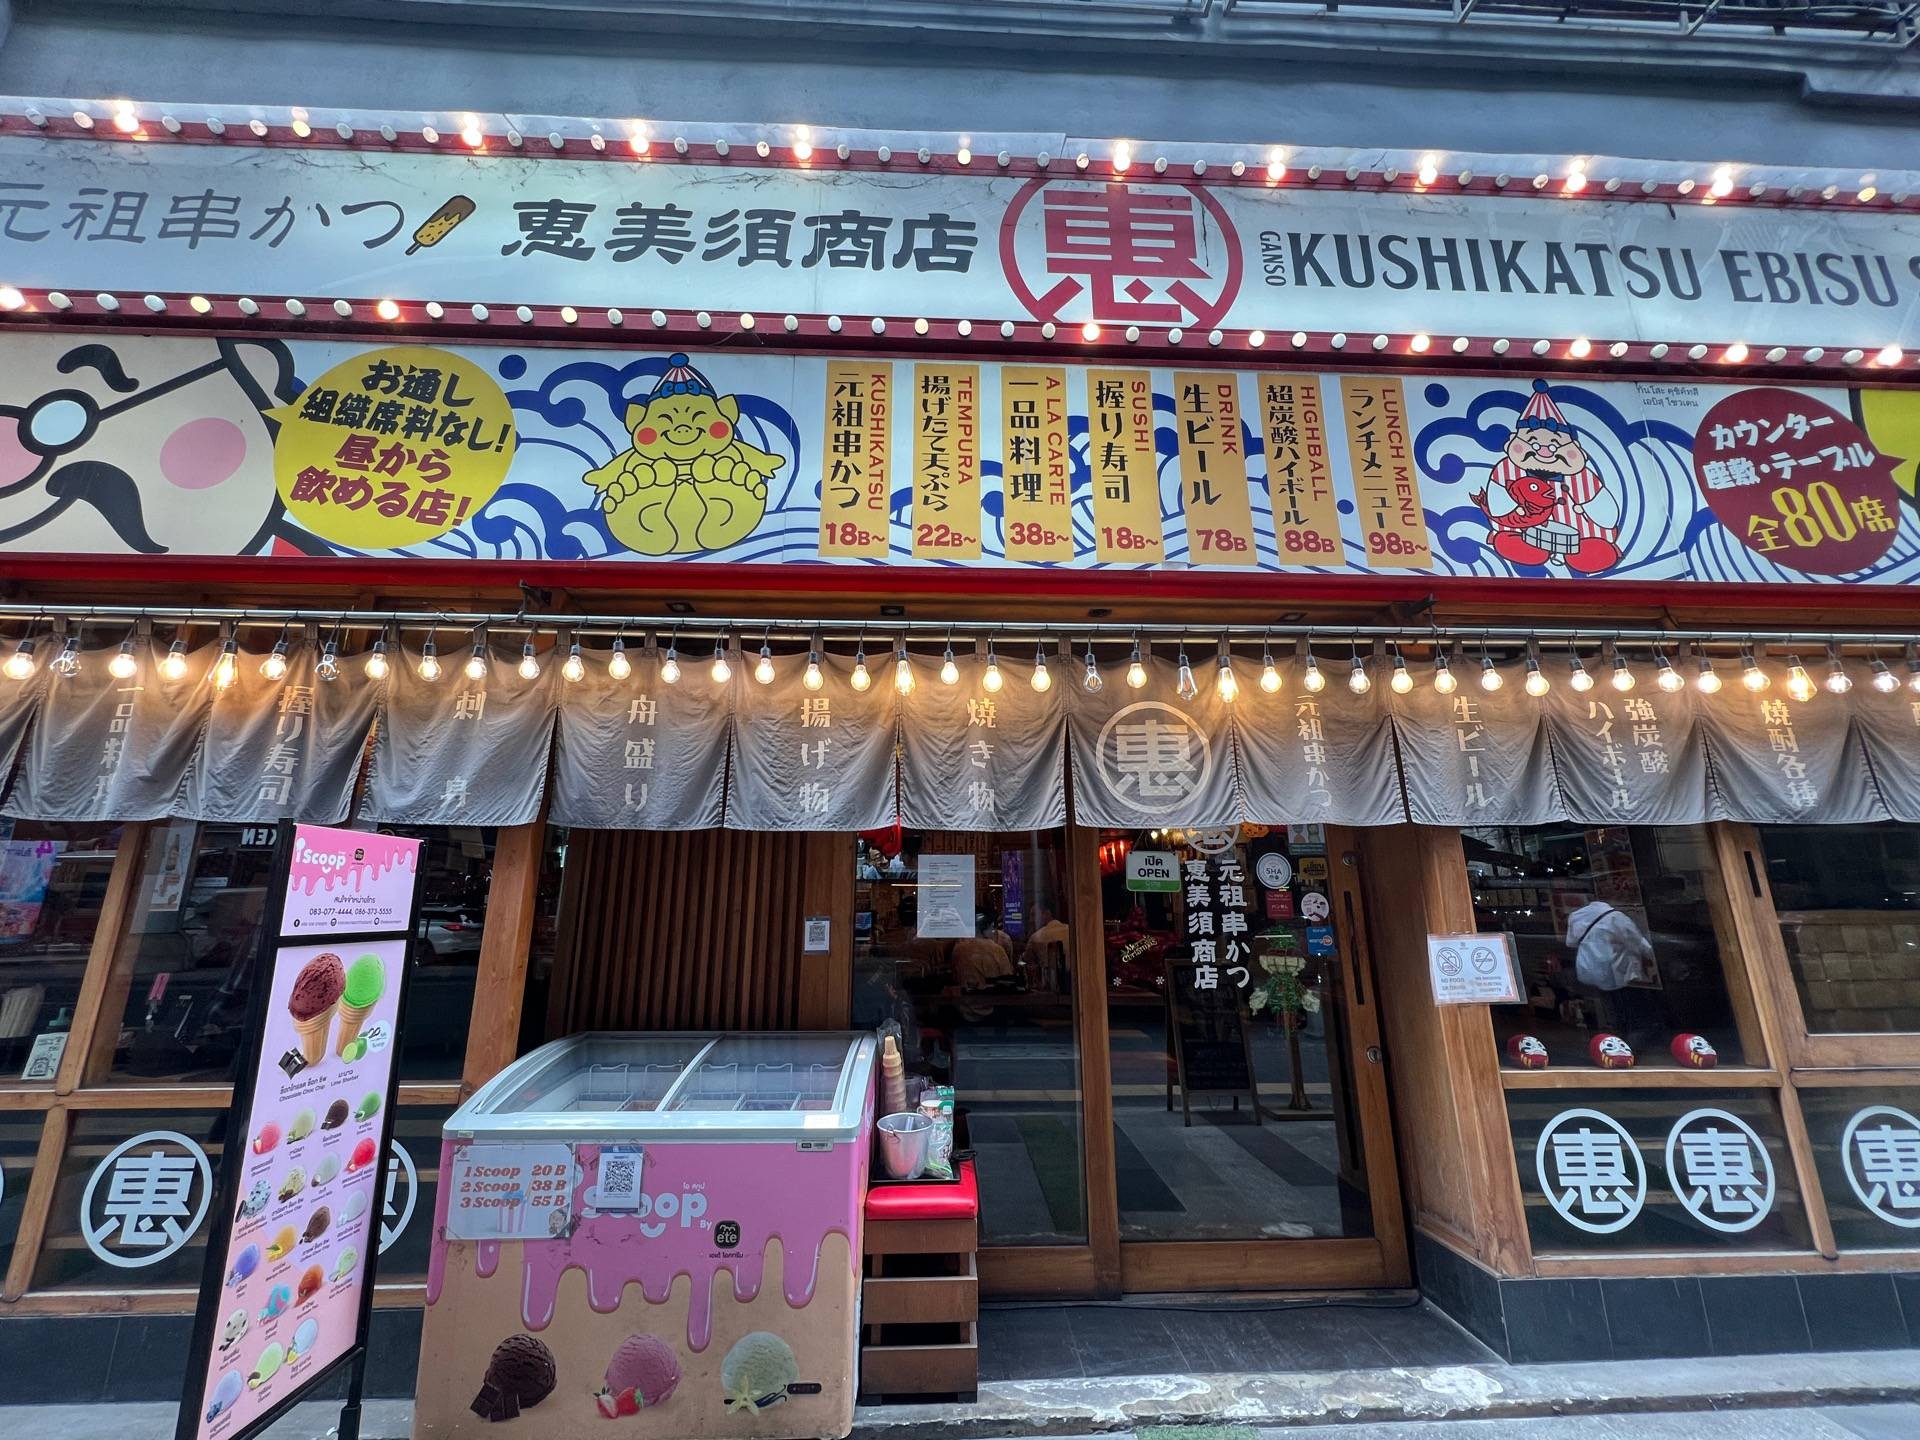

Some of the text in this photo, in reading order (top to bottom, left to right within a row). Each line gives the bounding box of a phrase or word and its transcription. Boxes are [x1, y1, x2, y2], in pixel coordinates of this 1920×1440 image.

[0, 183, 405, 250] 元祖串かつ
[1259, 230, 1287, 287] GANSO
[1287, 231, 1702, 301] KUSHIKATSU
[1718, 249, 1901, 308] EBISU
[361, 359, 475, 407] お通し
[957, 376, 973, 486] TEMPURA
[1131, 381, 1150, 453] SUSHI
[1217, 384, 1238, 455] DRINK
[1709, 412, 1834, 451] カウンター
[335, 433, 452, 484] 昼から
[830, 372, 864, 509] 元祖串かつ
[867, 374, 887, 511] KUSHIKATSU
[920, 375, 952, 512] 揚げたて天ぷら
[1008, 380, 1043, 503] 一品料理
[1046, 376, 1066, 506] A LA CARTE
[1096, 380, 1131, 504] 握り寿司
[1183, 383, 1222, 506] 生ビール
[1266, 384, 1310, 526] 超炭酸ハイボール
[1299, 386, 1328, 502] HIGHBALL
[1350, 387, 1392, 529] ランチメニュー
[1381, 388, 1418, 527] LUNCH MENU
[1196, 528, 1248, 552] 78B
[1284, 529, 1336, 553] 88B
[1748, 481, 1896, 552] 全80席
[623, 694, 659, 812] 舟盛り
[799, 698, 832, 813] 揚げ物
[966, 698, 998, 813] 焼き物
[1294, 695, 1333, 808] 元祖串かつ
[1452, 696, 1496, 809] 生ビール
[1137, 868, 1170, 878] OPEN
[1217, 859, 1251, 989] 元祖串かつ
[460, 1195, 566, 1210] 3 Scoop 55 B
[461, 1179, 567, 1193] 2 Scoop 38 B
[464, 1164, 567, 1179] 1 Scoop 20 B
